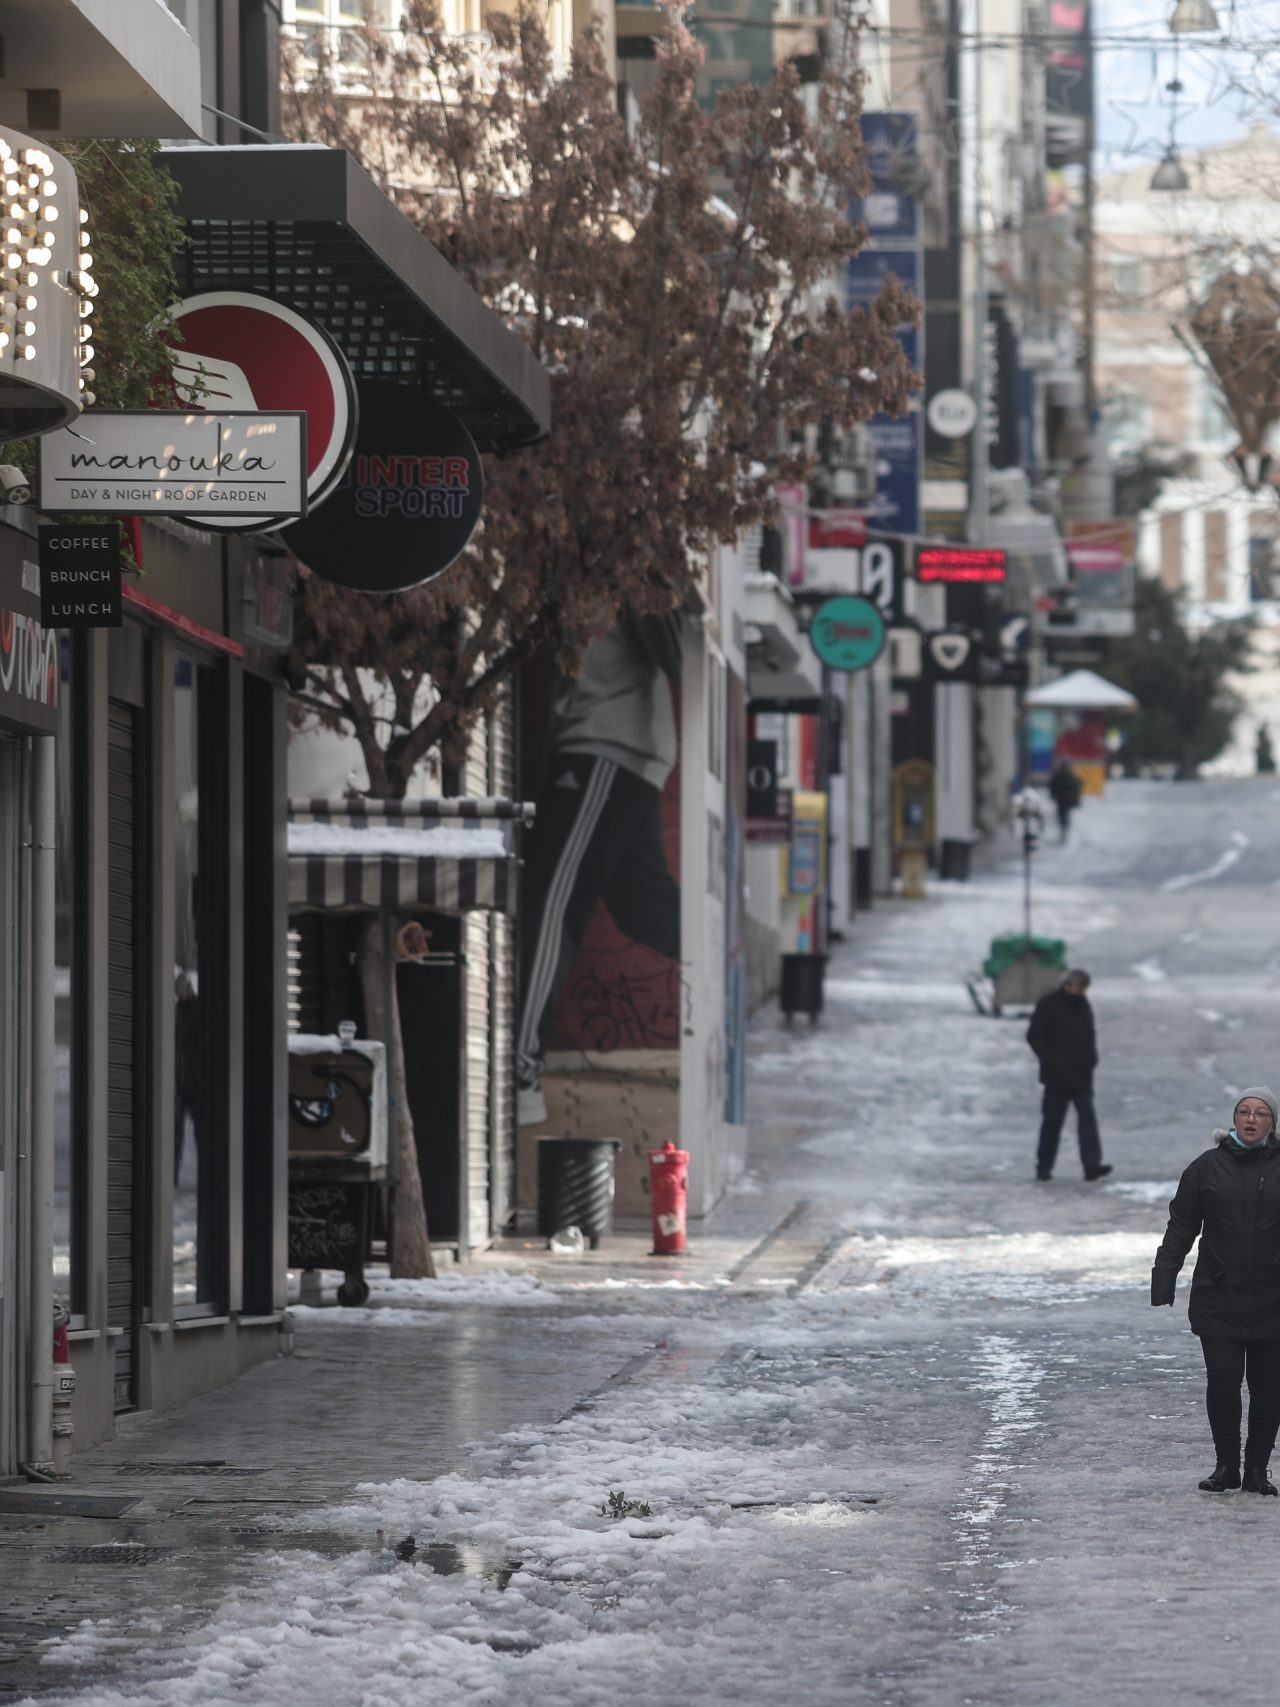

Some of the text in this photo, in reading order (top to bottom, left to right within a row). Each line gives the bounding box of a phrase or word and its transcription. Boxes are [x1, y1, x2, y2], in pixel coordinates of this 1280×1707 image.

[71, 423, 277, 476] manouka
[357, 454, 469, 487] INTER
[71, 488, 267, 502] DAY & NIGHT ROOF GARDEN
[355, 485, 470, 519] SPORT
[49, 537, 110, 549] COFFEE
[51, 570, 111, 582] BRUNCH
[52, 603, 112, 615] LUNCH
